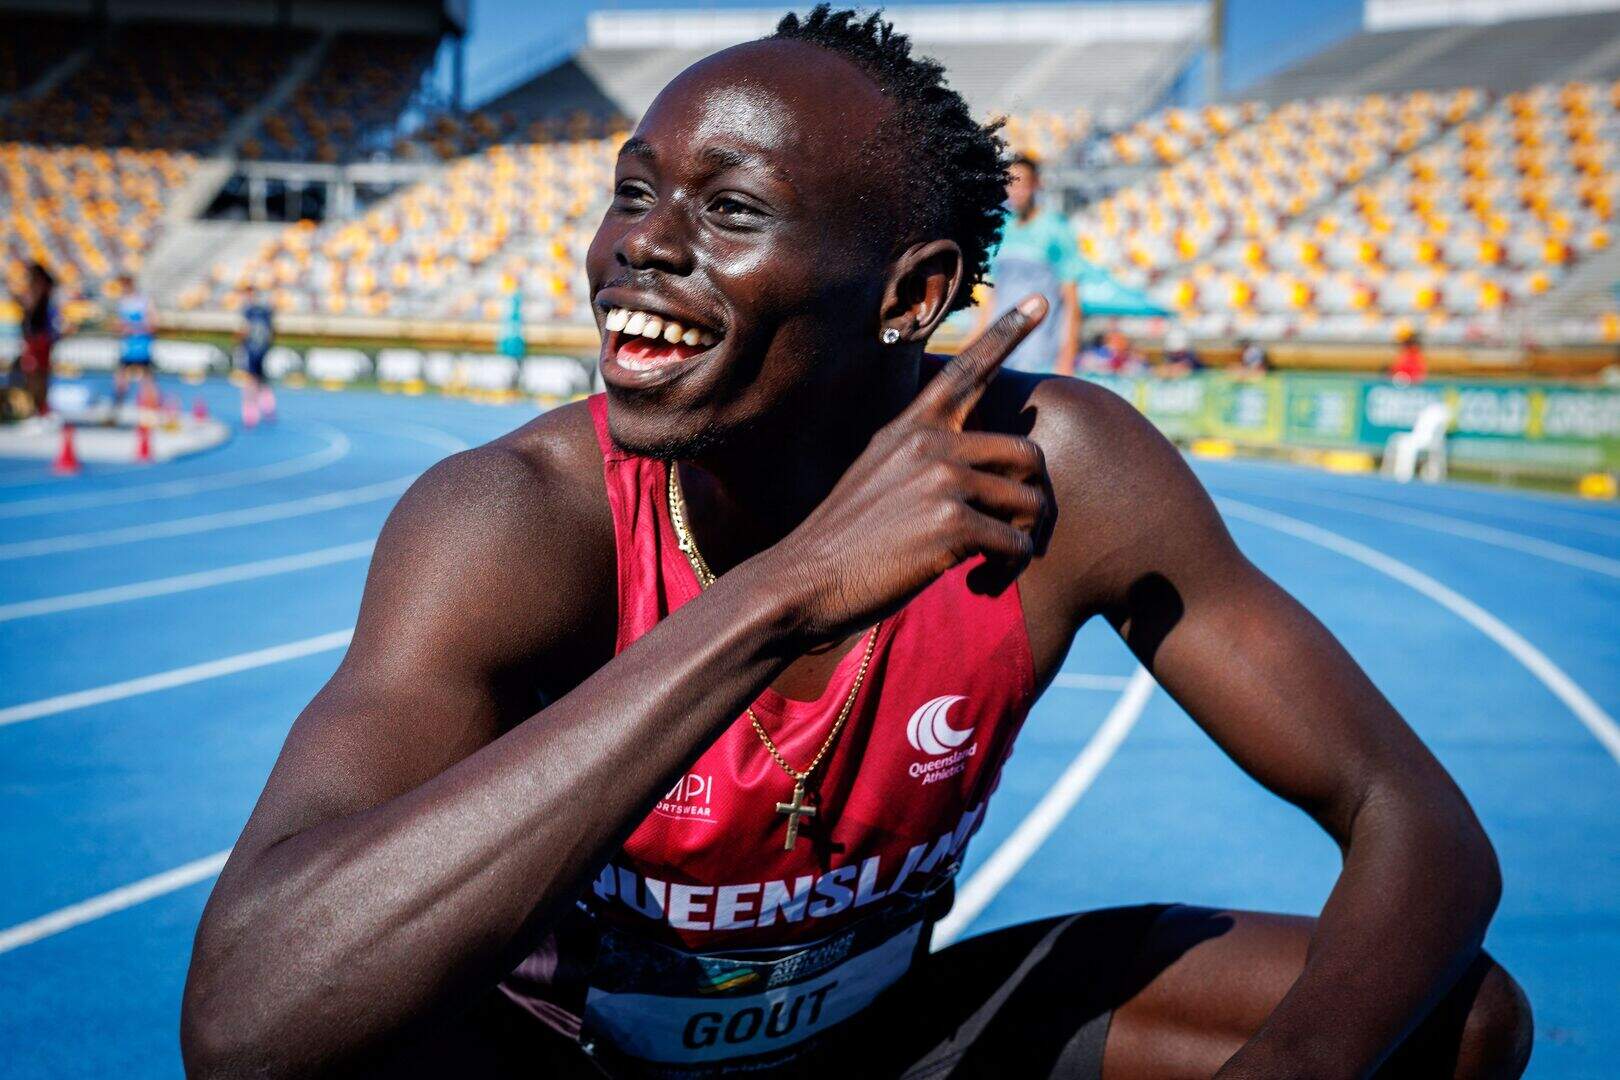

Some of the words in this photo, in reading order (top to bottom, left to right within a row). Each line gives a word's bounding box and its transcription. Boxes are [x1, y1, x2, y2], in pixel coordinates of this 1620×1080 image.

[908, 742, 978, 777] Queensland
[921, 762, 965, 786] Athletics
[664, 773, 713, 804] MPI
[655, 802, 712, 816] ORTSWEAR
[591, 802, 984, 931] UEENSLAN
[683, 980, 839, 1049] GOUT
